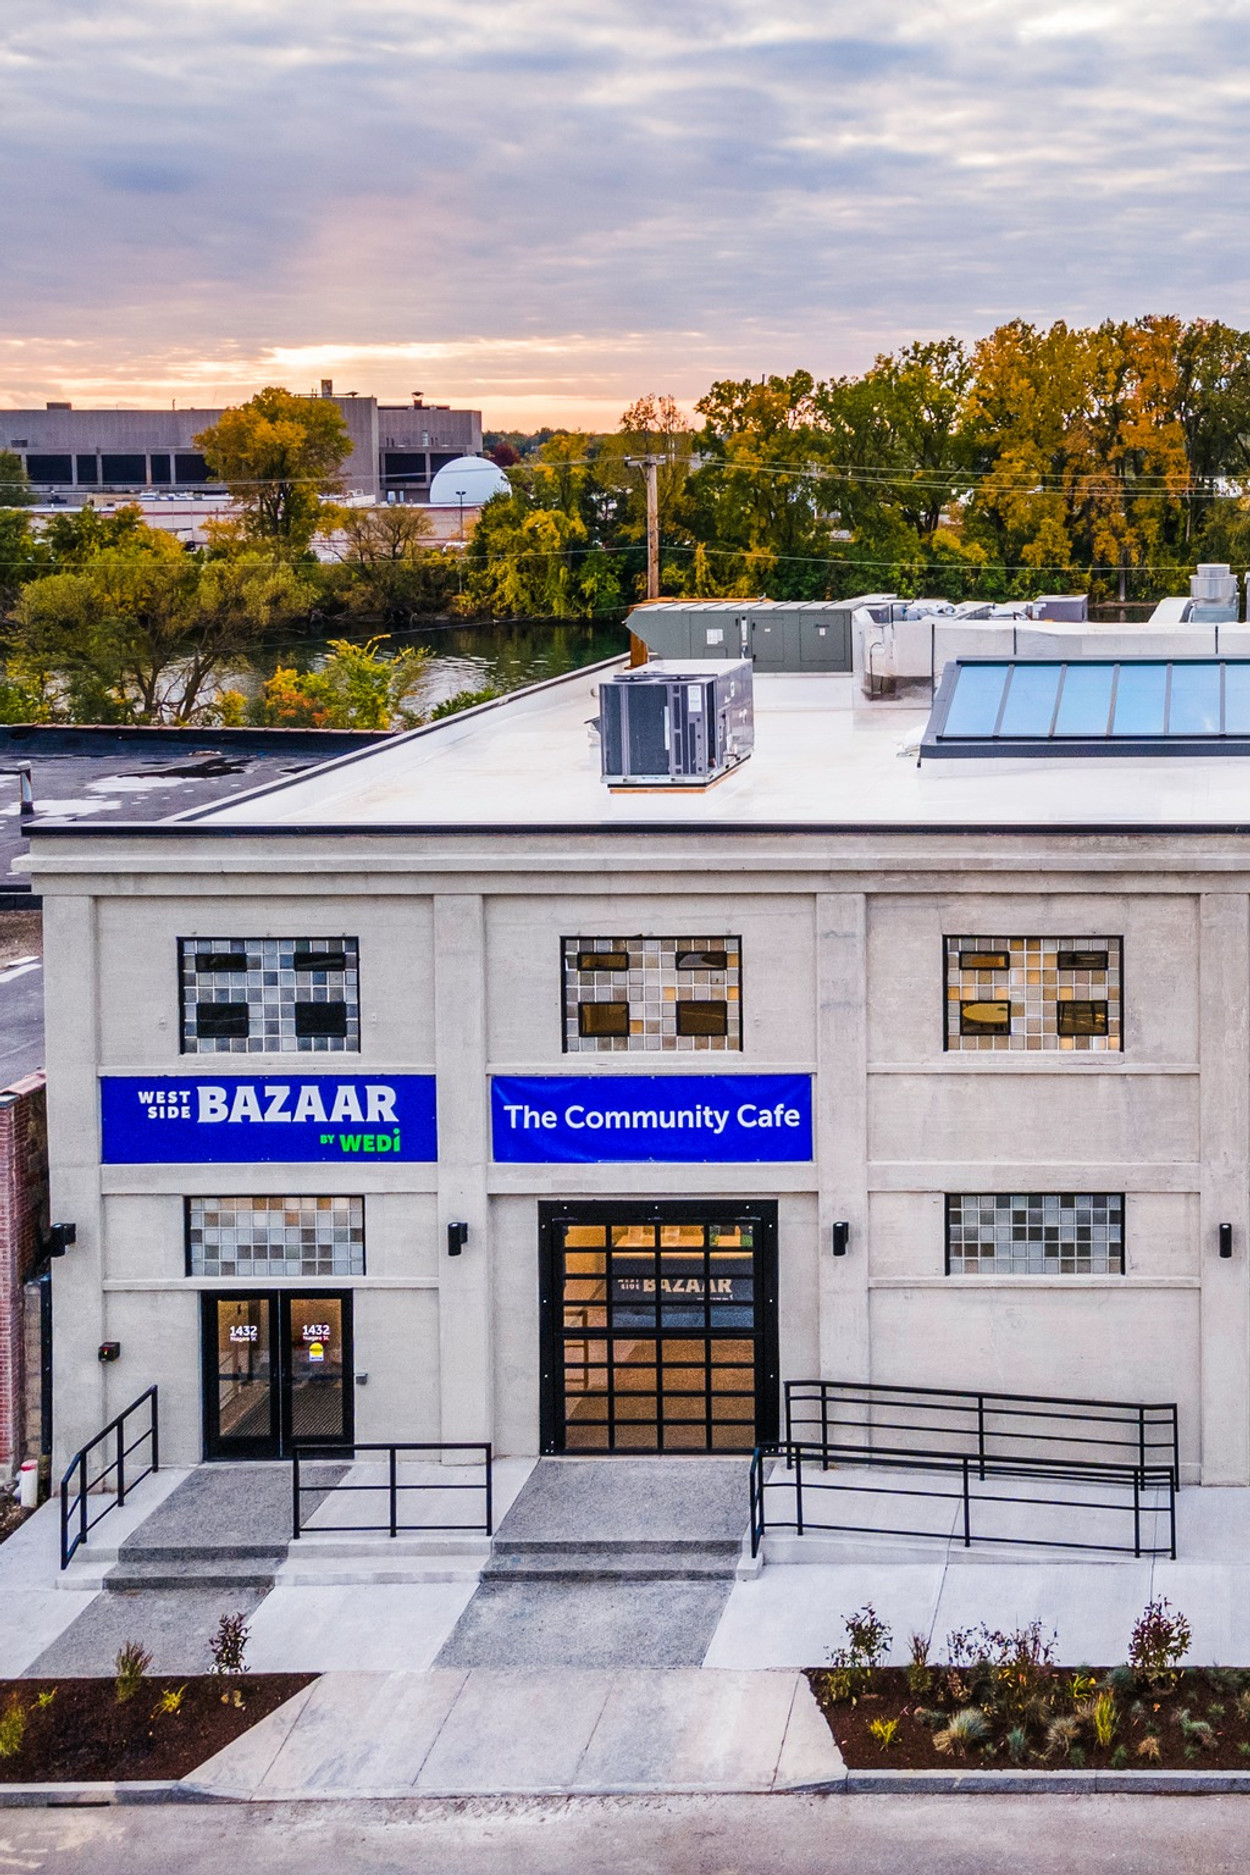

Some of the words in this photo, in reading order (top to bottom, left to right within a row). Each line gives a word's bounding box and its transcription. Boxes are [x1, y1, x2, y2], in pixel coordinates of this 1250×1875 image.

[138, 1091, 191, 1104] WEST
[196, 1085, 399, 1123] BAZAAR
[148, 1106, 191, 1119] SIDE
[503, 1104, 557, 1129] The
[564, 1104, 729, 1134] Community
[736, 1103, 800, 1128] Cafe
[320, 1135, 335, 1144] BY
[229, 1325, 258, 1337] 1432
[302, 1324, 330, 1336] 1432
